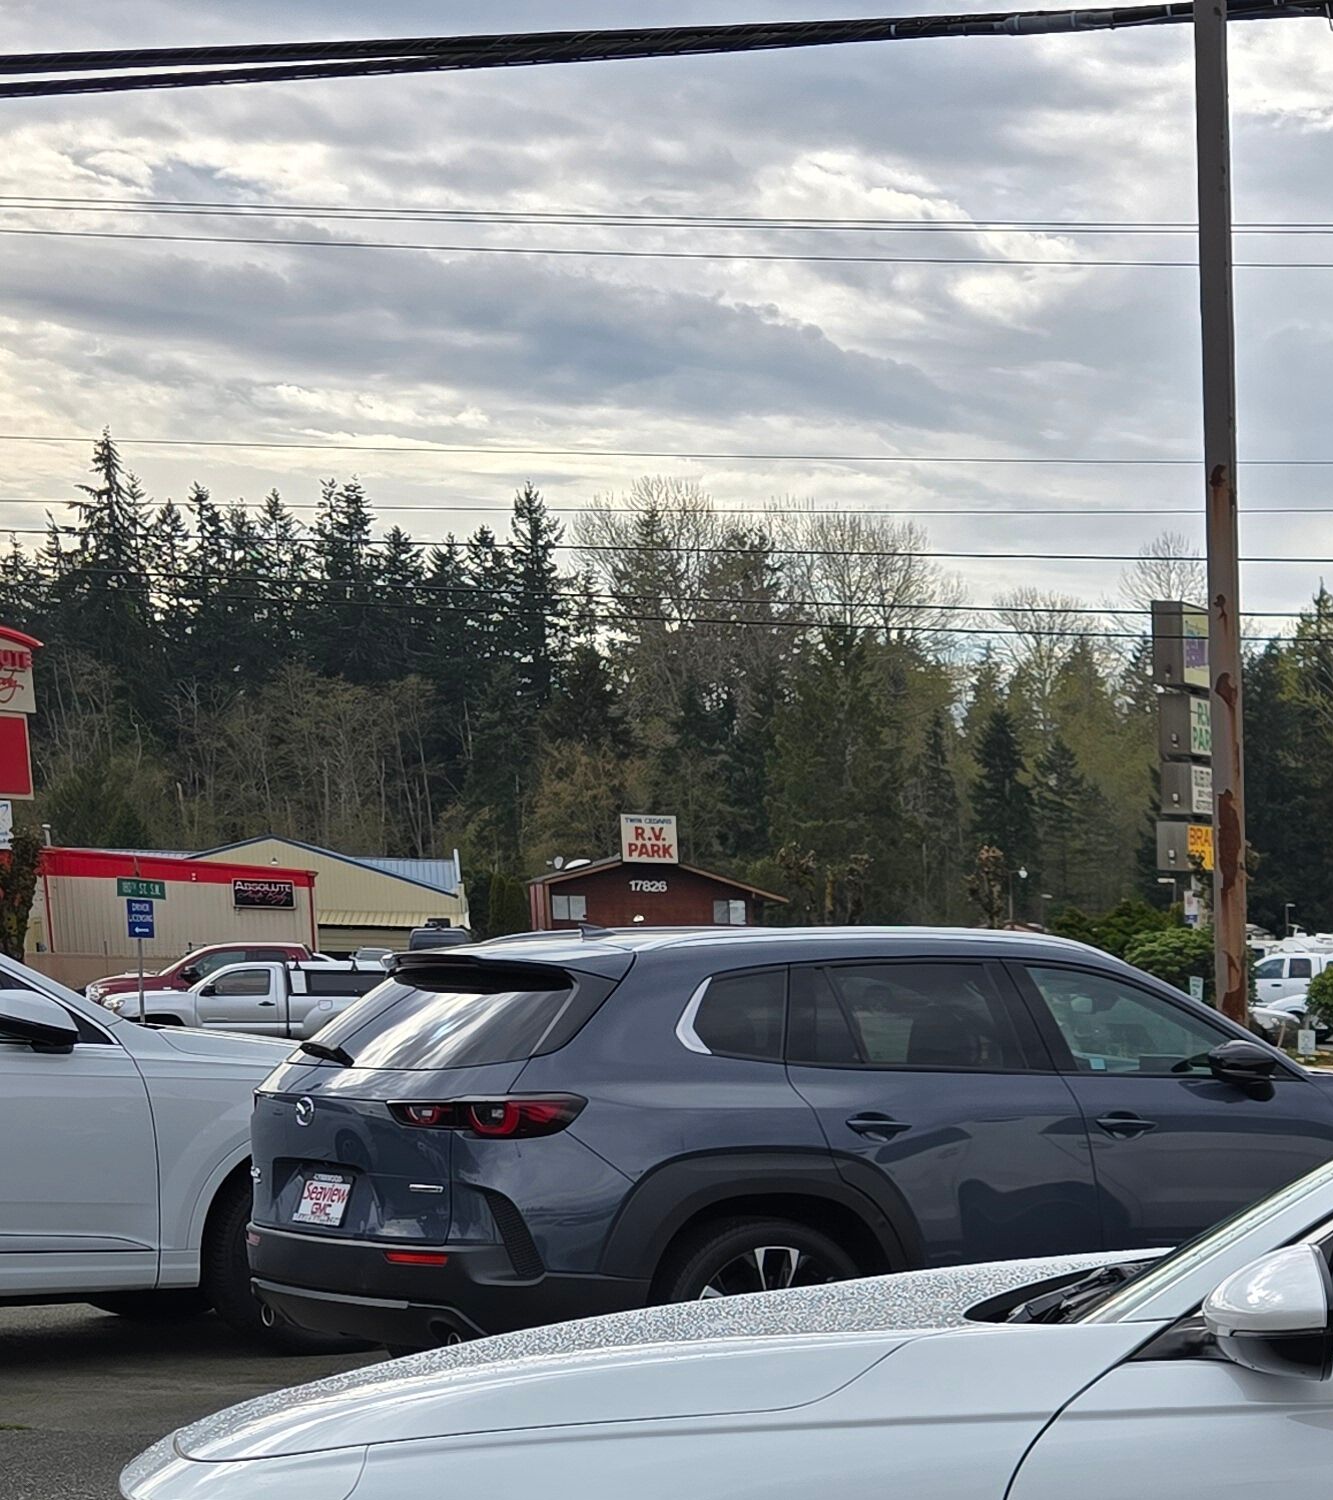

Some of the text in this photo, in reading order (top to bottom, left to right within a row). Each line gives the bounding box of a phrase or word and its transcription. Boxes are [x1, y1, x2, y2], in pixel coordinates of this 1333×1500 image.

[0, 650, 32, 668] UTE
[1193, 726, 1212, 751] PAR
[634, 826, 666, 841] R.V.
[1189, 827, 1212, 847] BRA
[628, 842, 674, 859] PARK
[629, 879, 668, 893] 17826
[303, 1182, 349, 1204] Seaview
[310, 1202, 332, 1216] GMC
